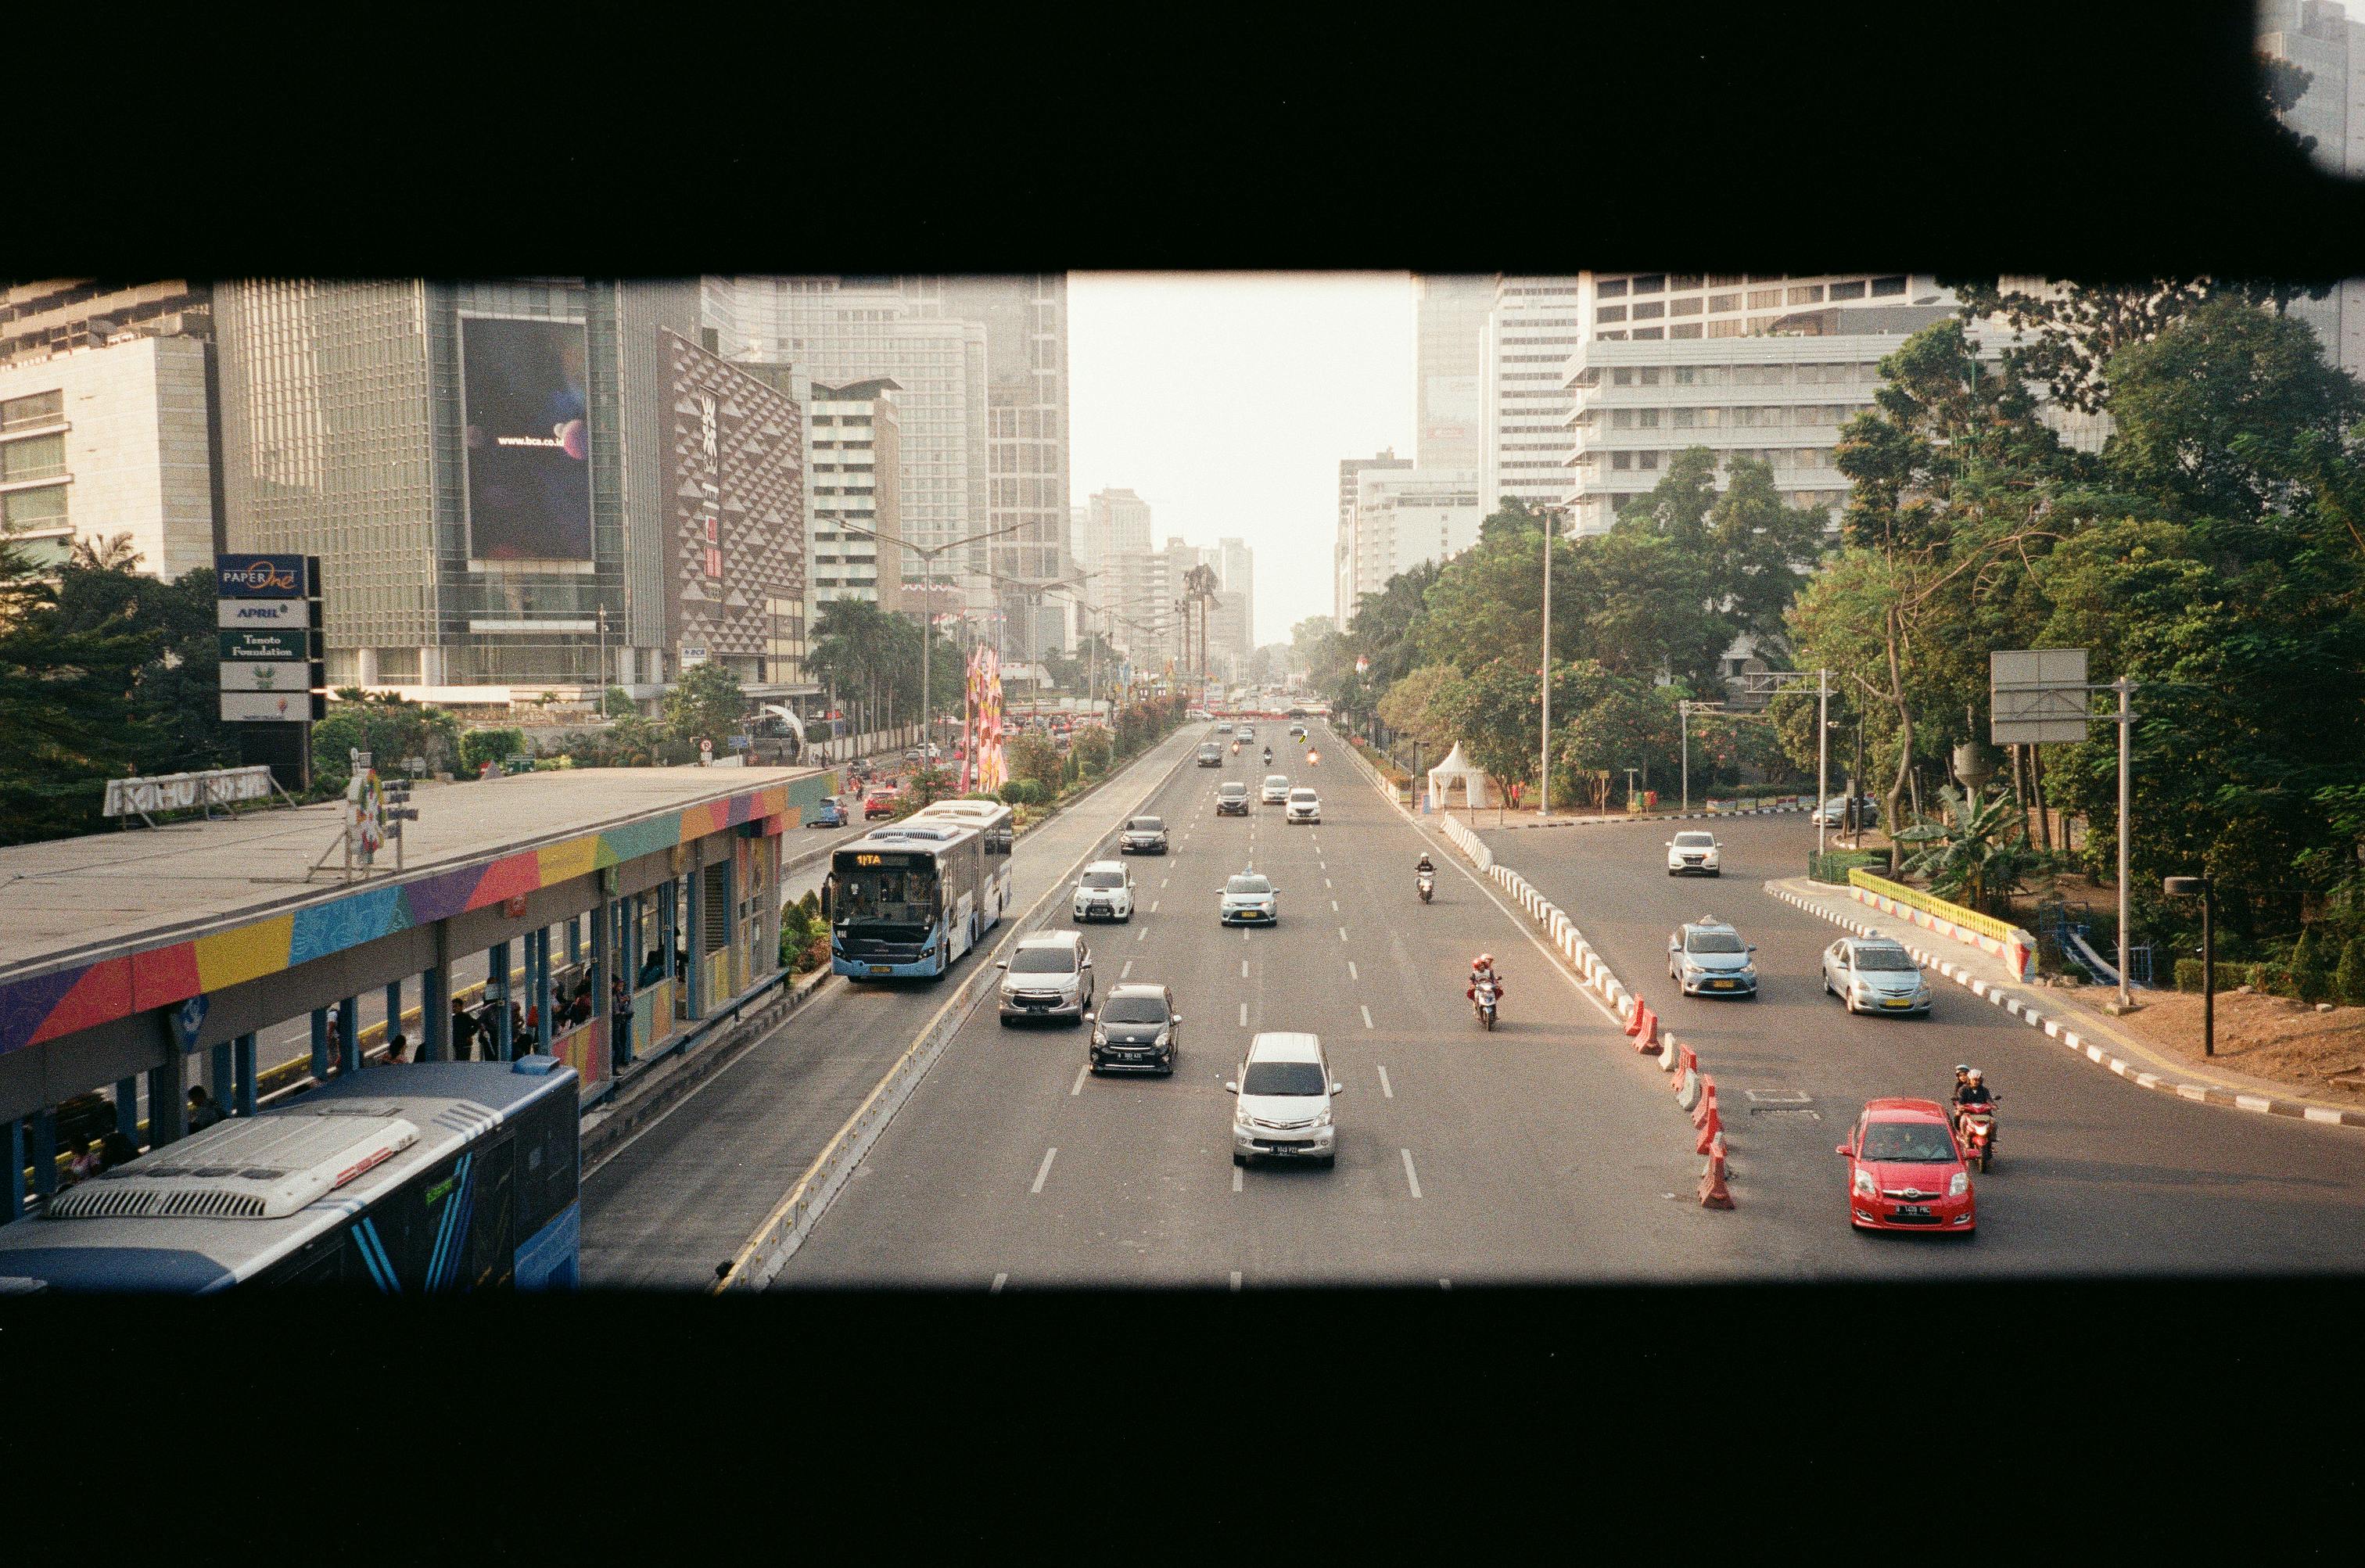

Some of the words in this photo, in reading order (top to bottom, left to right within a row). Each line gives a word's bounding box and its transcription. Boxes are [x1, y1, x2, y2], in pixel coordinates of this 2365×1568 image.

[497, 436, 564, 447] www.bca.co.id
[223, 572, 266, 583] PAPER
[237, 608, 278, 618] APRIL
[232, 646, 292, 657] Foundation
